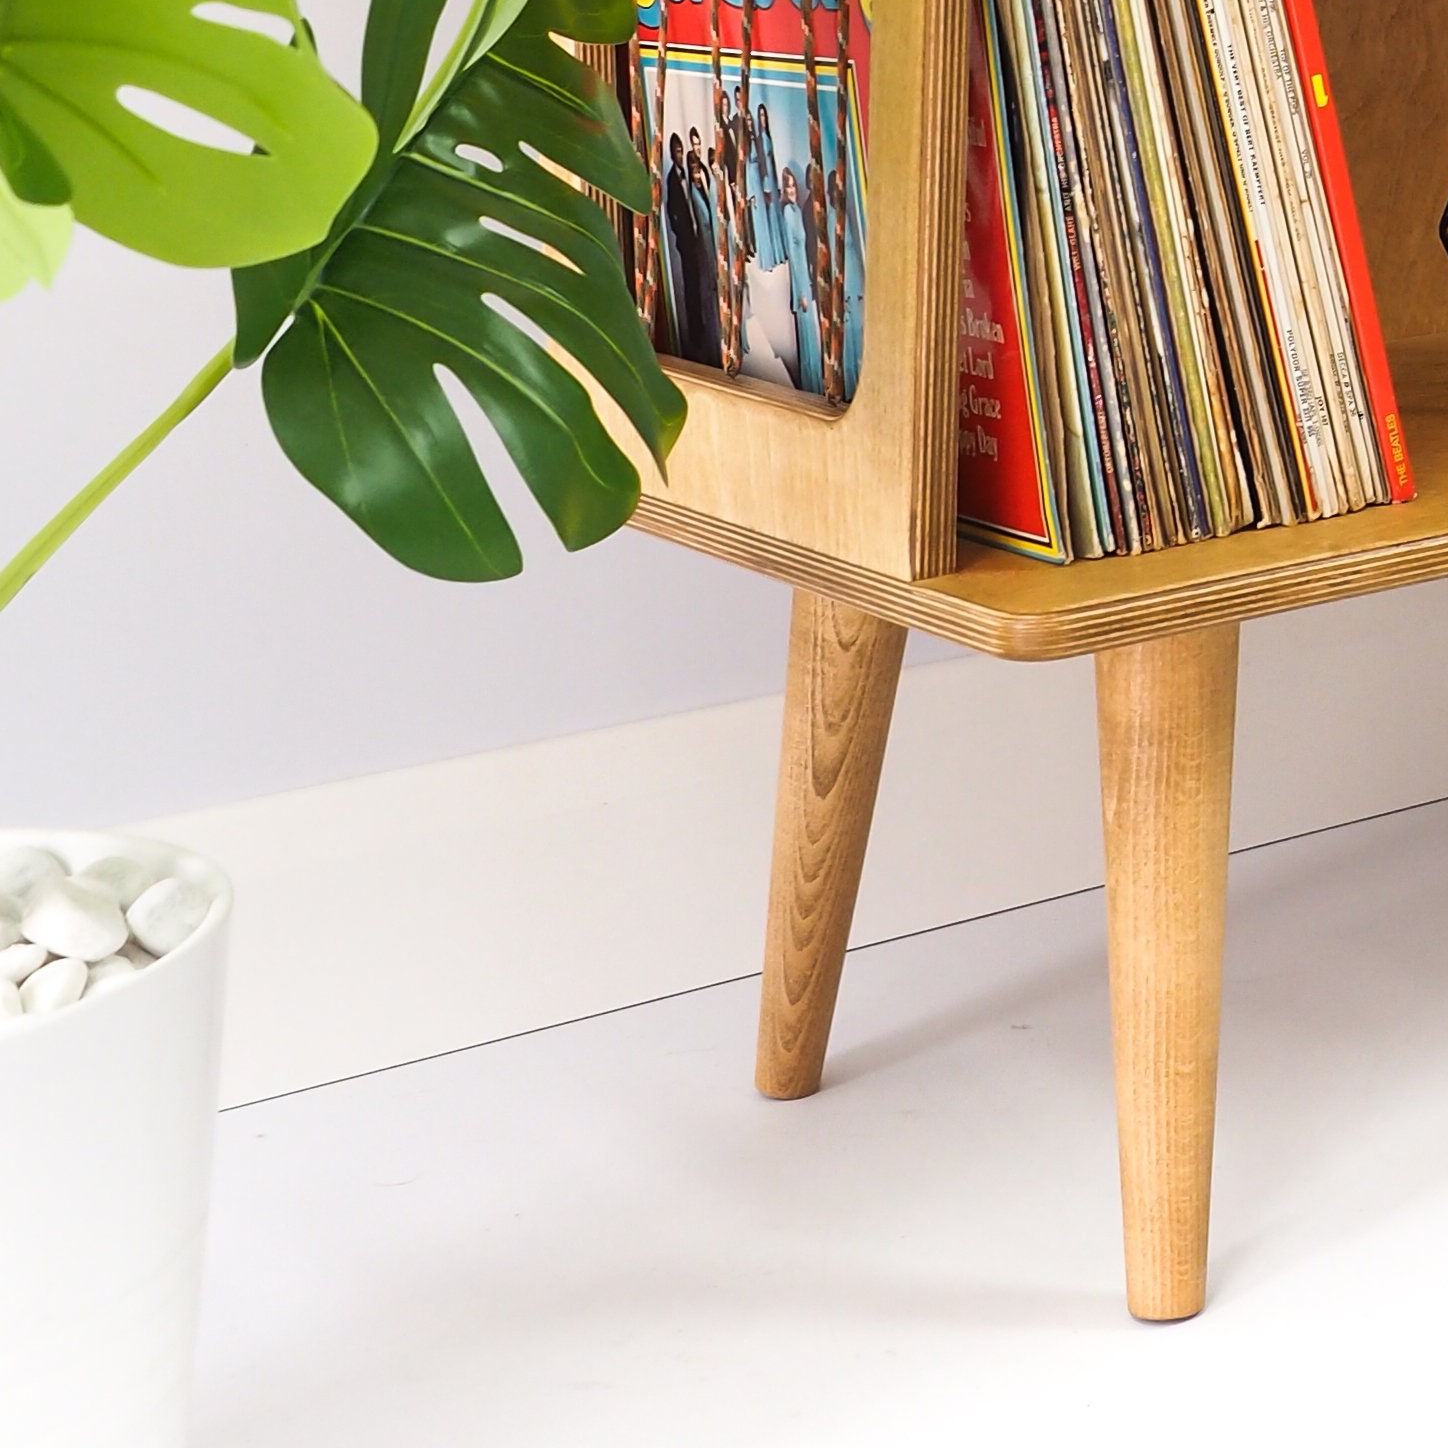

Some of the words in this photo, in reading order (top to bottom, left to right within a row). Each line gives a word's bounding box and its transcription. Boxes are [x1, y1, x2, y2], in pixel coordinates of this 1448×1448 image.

[1231, 64, 1240, 87] VERY
[1236, 89, 1246, 112] BEST
[1241, 114, 1249, 126] OF
[1244, 129, 1255, 151] BERT
[1250, 153, 1266, 206] KAEMPFERT
[1063, 190, 1072, 212] AND
[1286, 330, 1300, 372] POLYDOR
[1296, 375, 1308, 405] SUPER
[1315, 396, 1325, 413] JOY
[1384, 414, 1404, 460] BEATLES
[1396, 462, 1408, 486] THE
